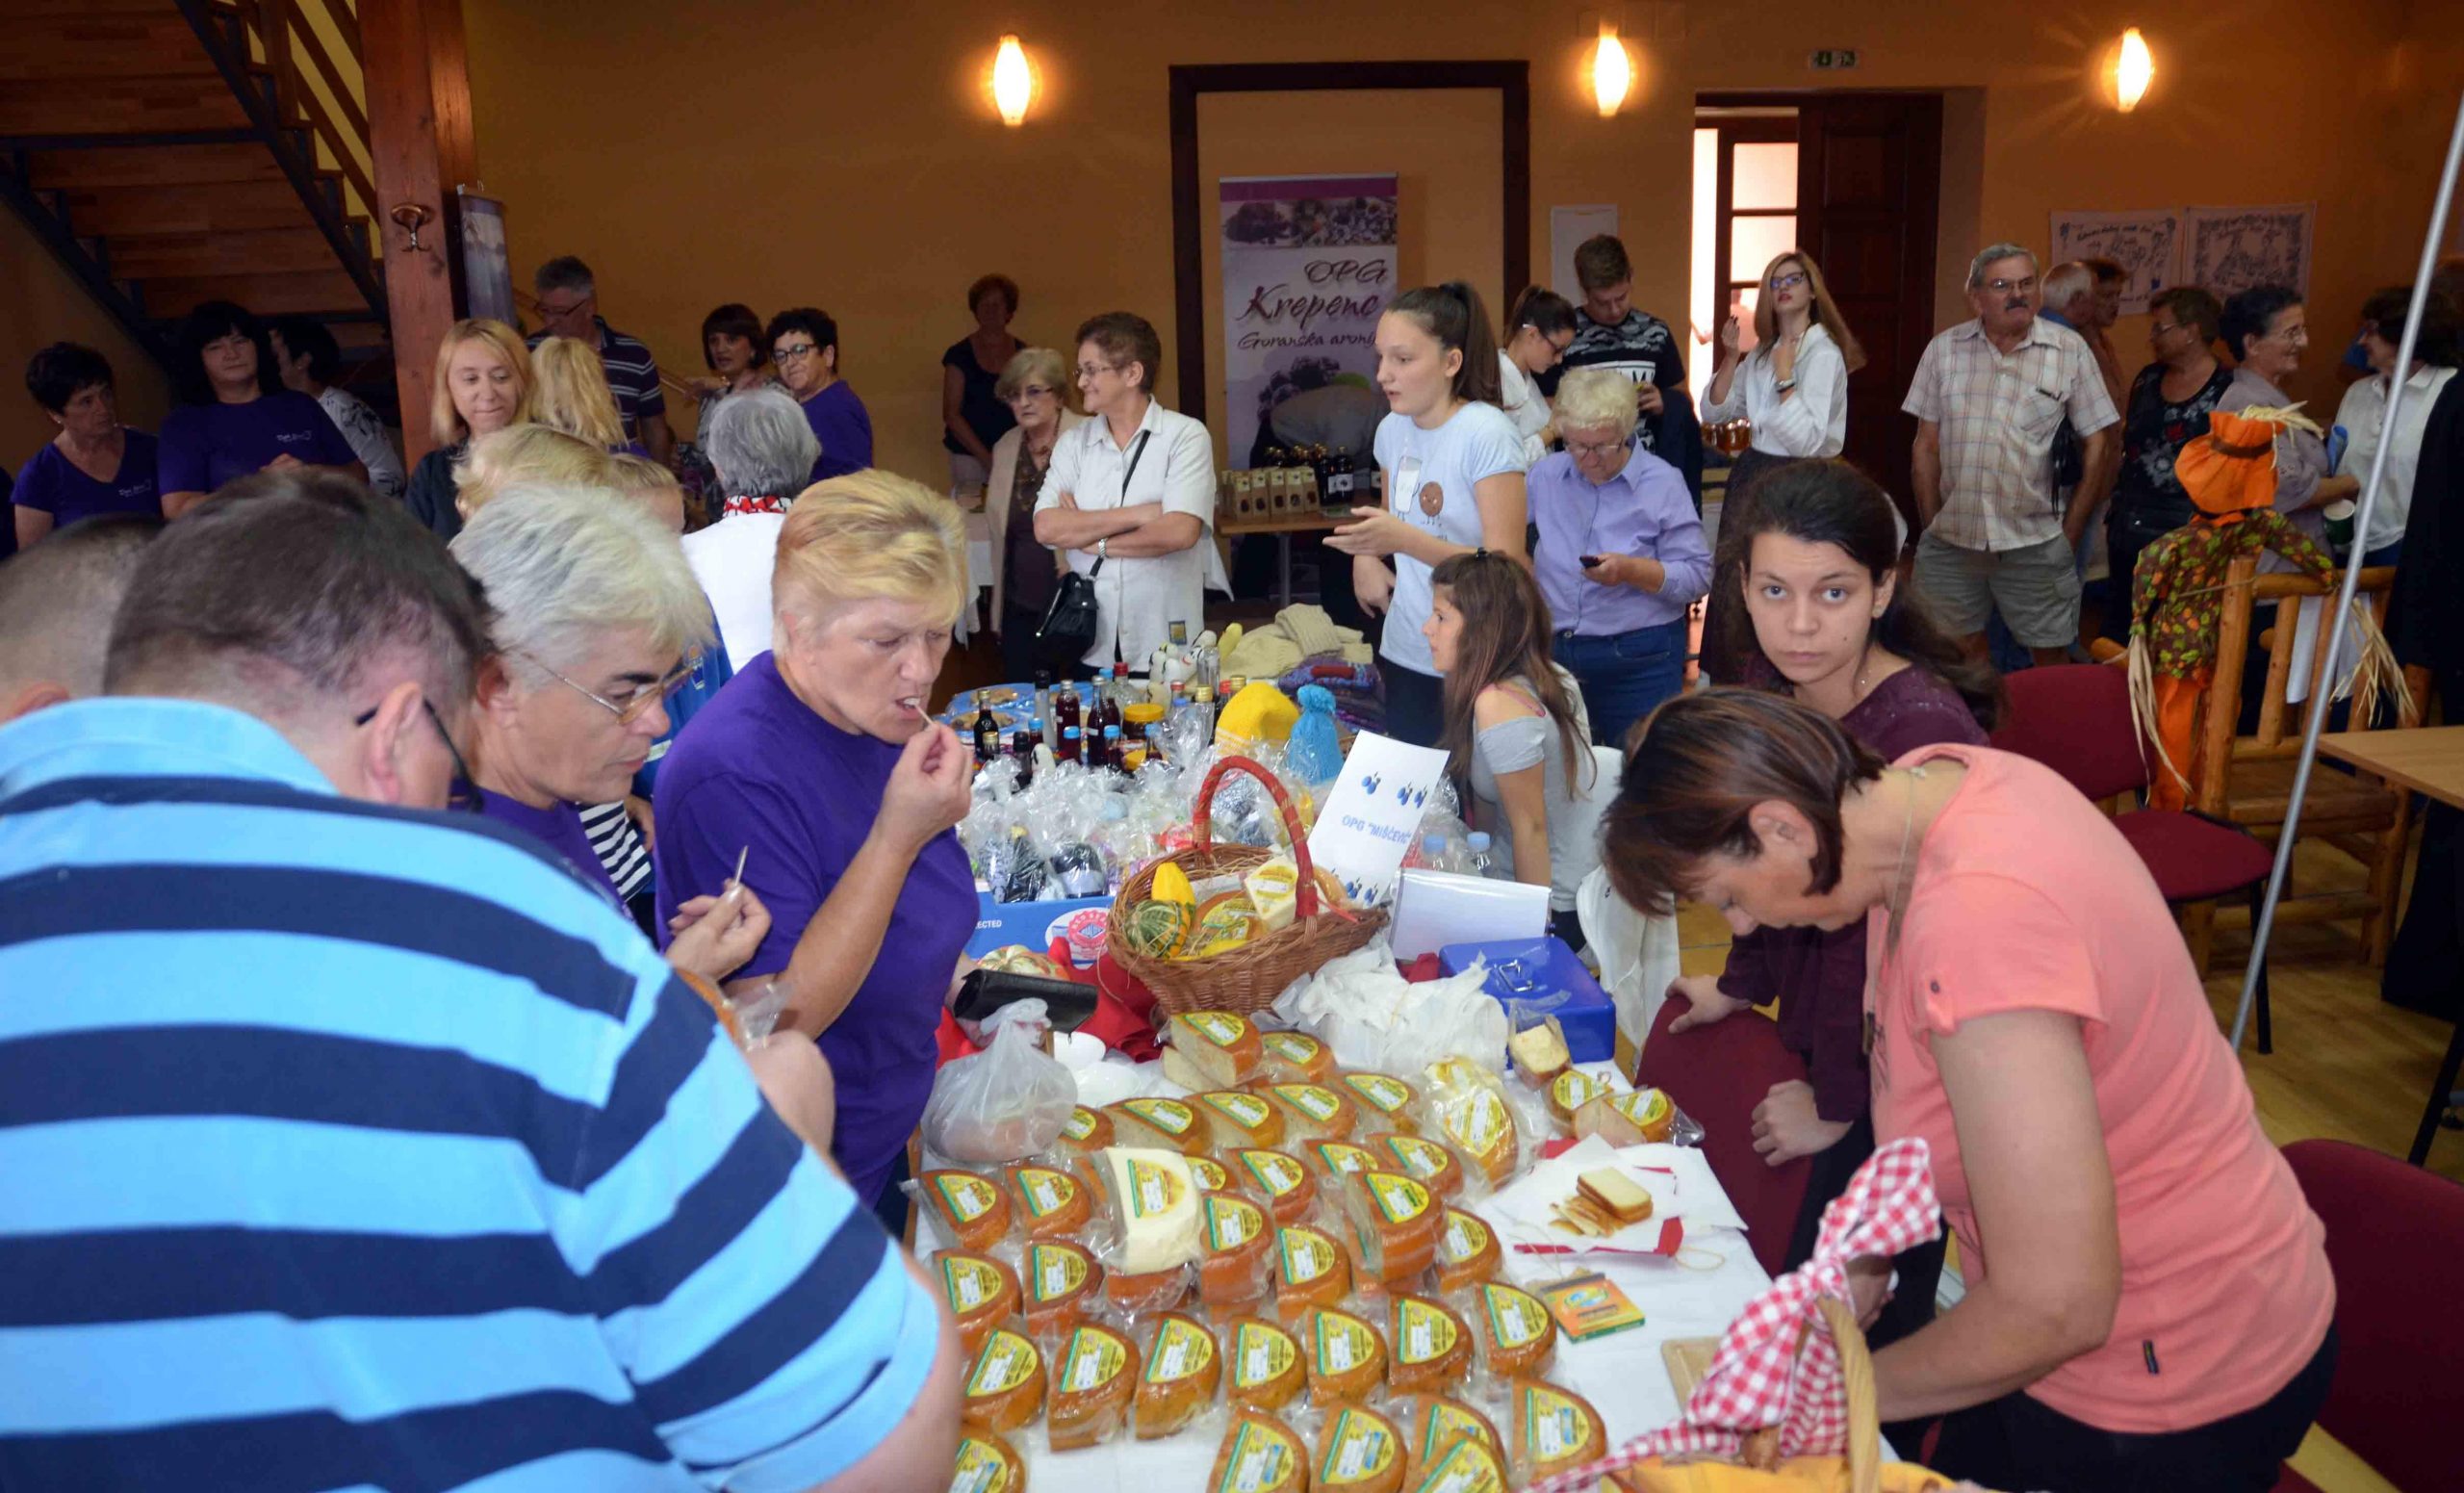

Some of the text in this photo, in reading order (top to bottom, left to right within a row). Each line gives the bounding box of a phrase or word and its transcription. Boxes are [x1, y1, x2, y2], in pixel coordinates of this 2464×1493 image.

[1304, 258, 1388, 284] OPG
[1236, 283, 1379, 330] Krepenc
[1237, 331, 1376, 350] Goranska aronij
[1342, 814, 1365, 832] OPG
[975, 919, 1003, 930] ECTED
